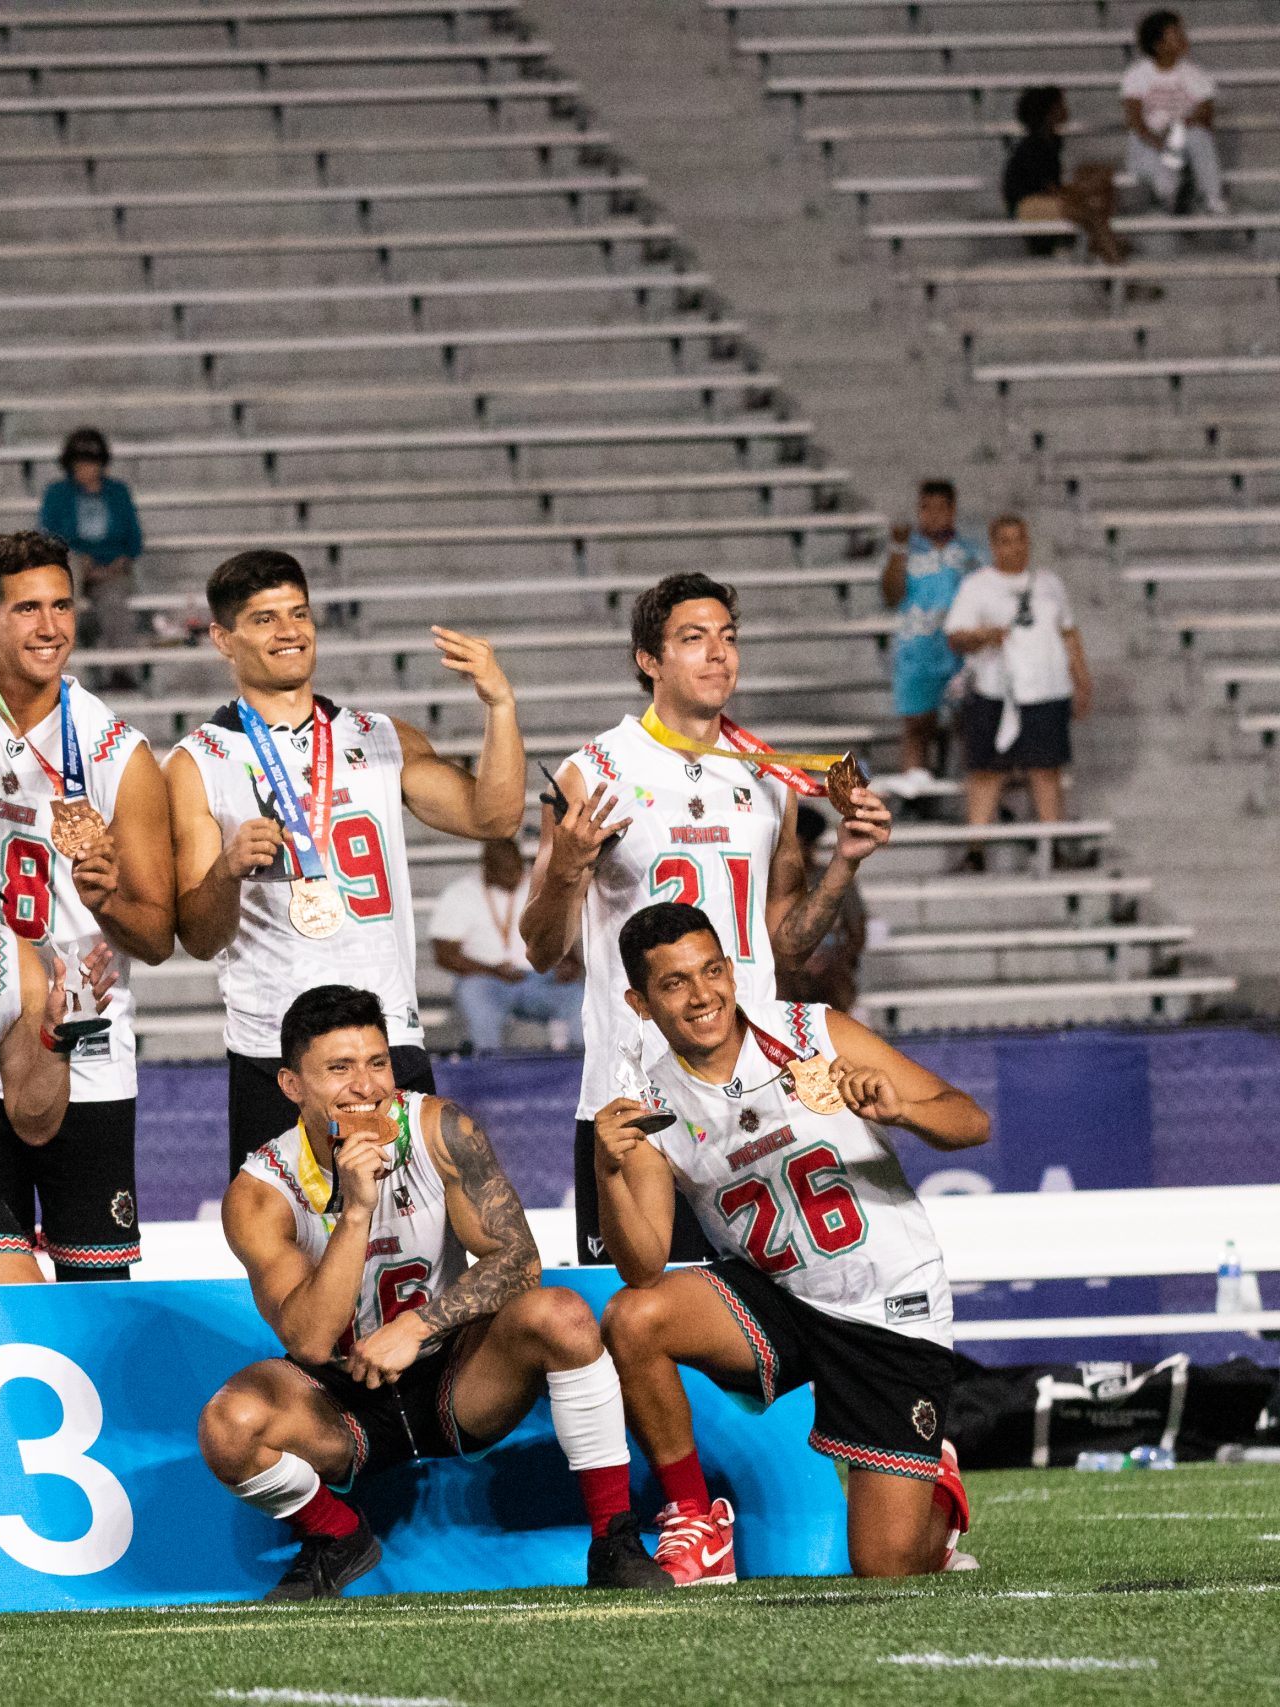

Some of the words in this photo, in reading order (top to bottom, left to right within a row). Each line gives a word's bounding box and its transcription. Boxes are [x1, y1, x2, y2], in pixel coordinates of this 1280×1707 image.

[318, 726, 327, 762] Birmingham
[260, 741, 277, 766] Games
[270, 764, 284, 782] 2022
[277, 780, 300, 823] Birmingham
[317, 762, 327, 778] 2022
[317, 778, 325, 802] Games
[314, 803, 324, 825] World
[313, 825, 323, 839] The
[649, 851, 756, 965] 21
[714, 1139, 869, 1278] 26
